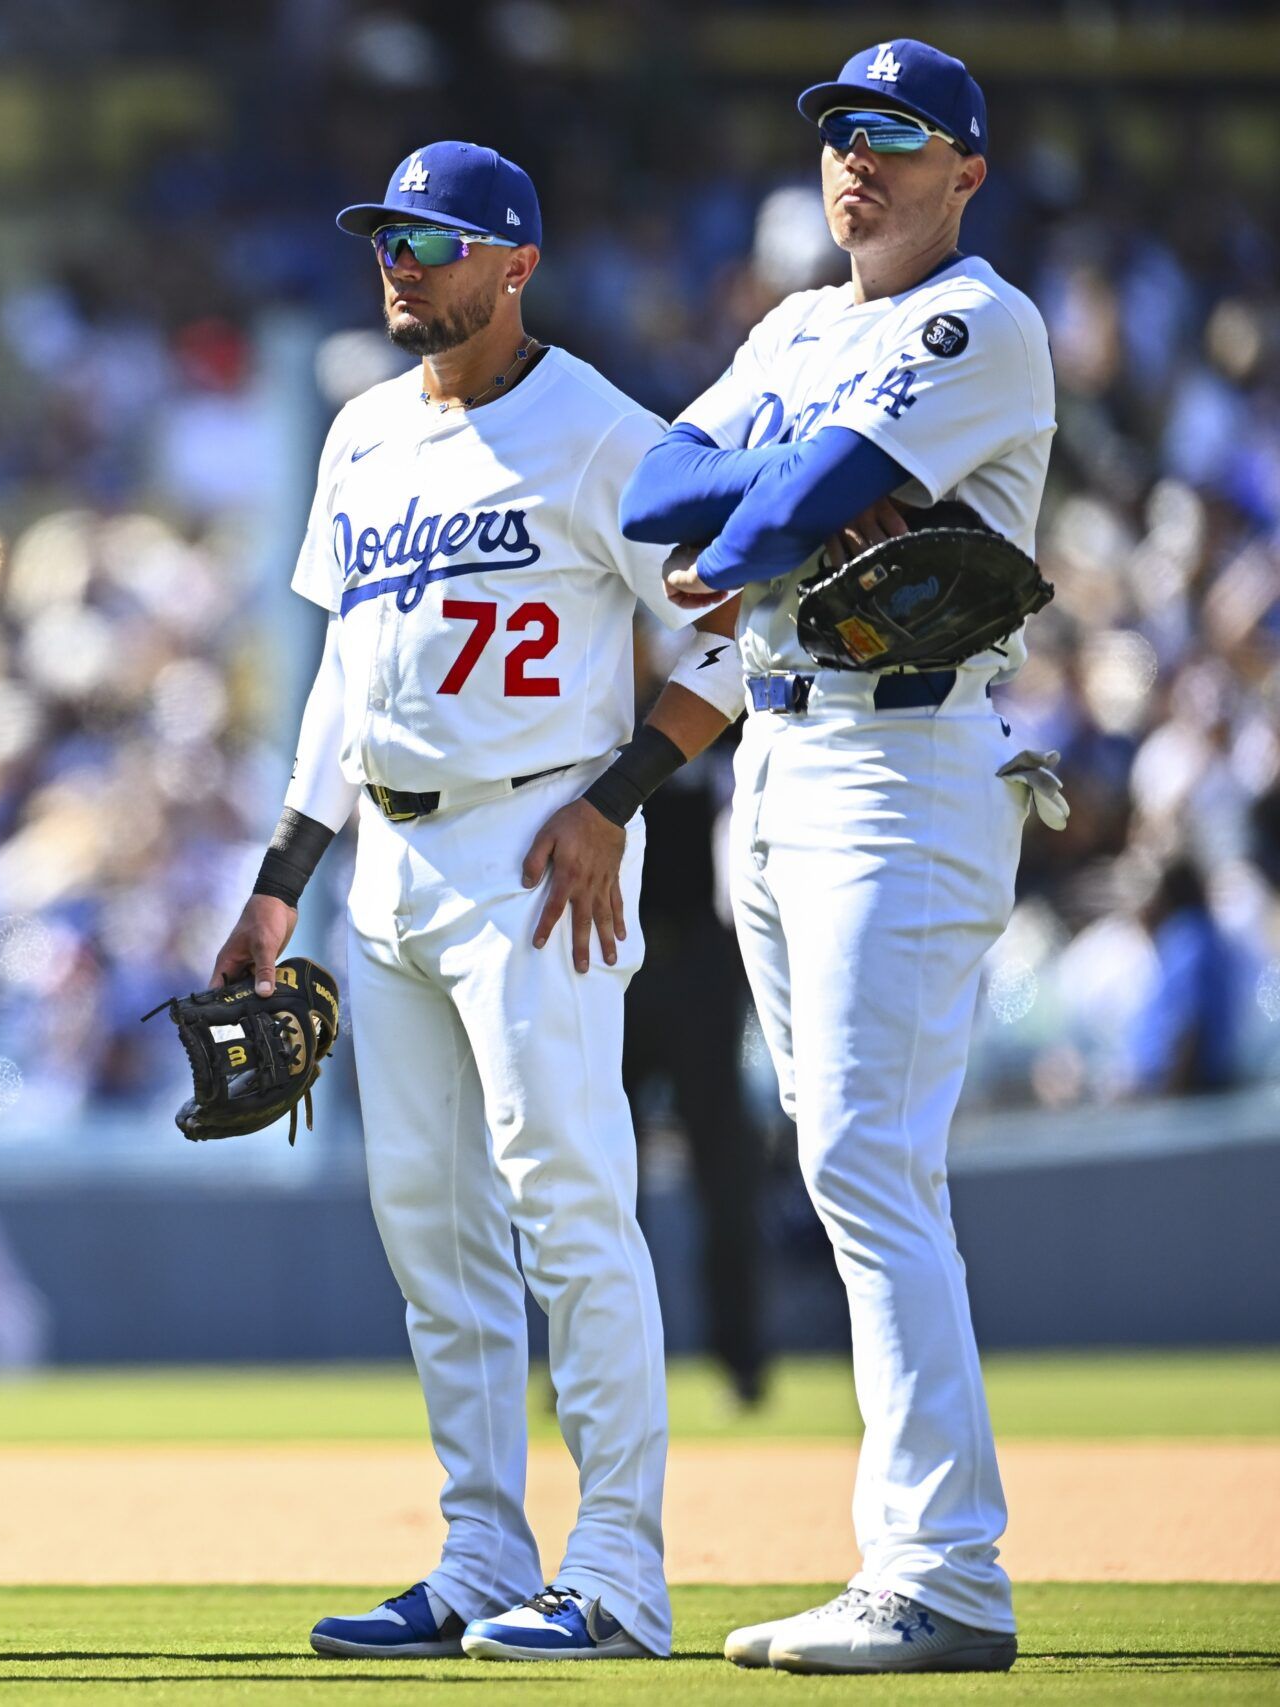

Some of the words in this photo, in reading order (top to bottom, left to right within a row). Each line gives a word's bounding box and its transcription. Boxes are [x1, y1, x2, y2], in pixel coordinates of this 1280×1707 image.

[866, 43, 901, 82] LA
[399, 151, 430, 192] LA
[926, 325, 958, 353] 34
[436, 599, 561, 698] 72
